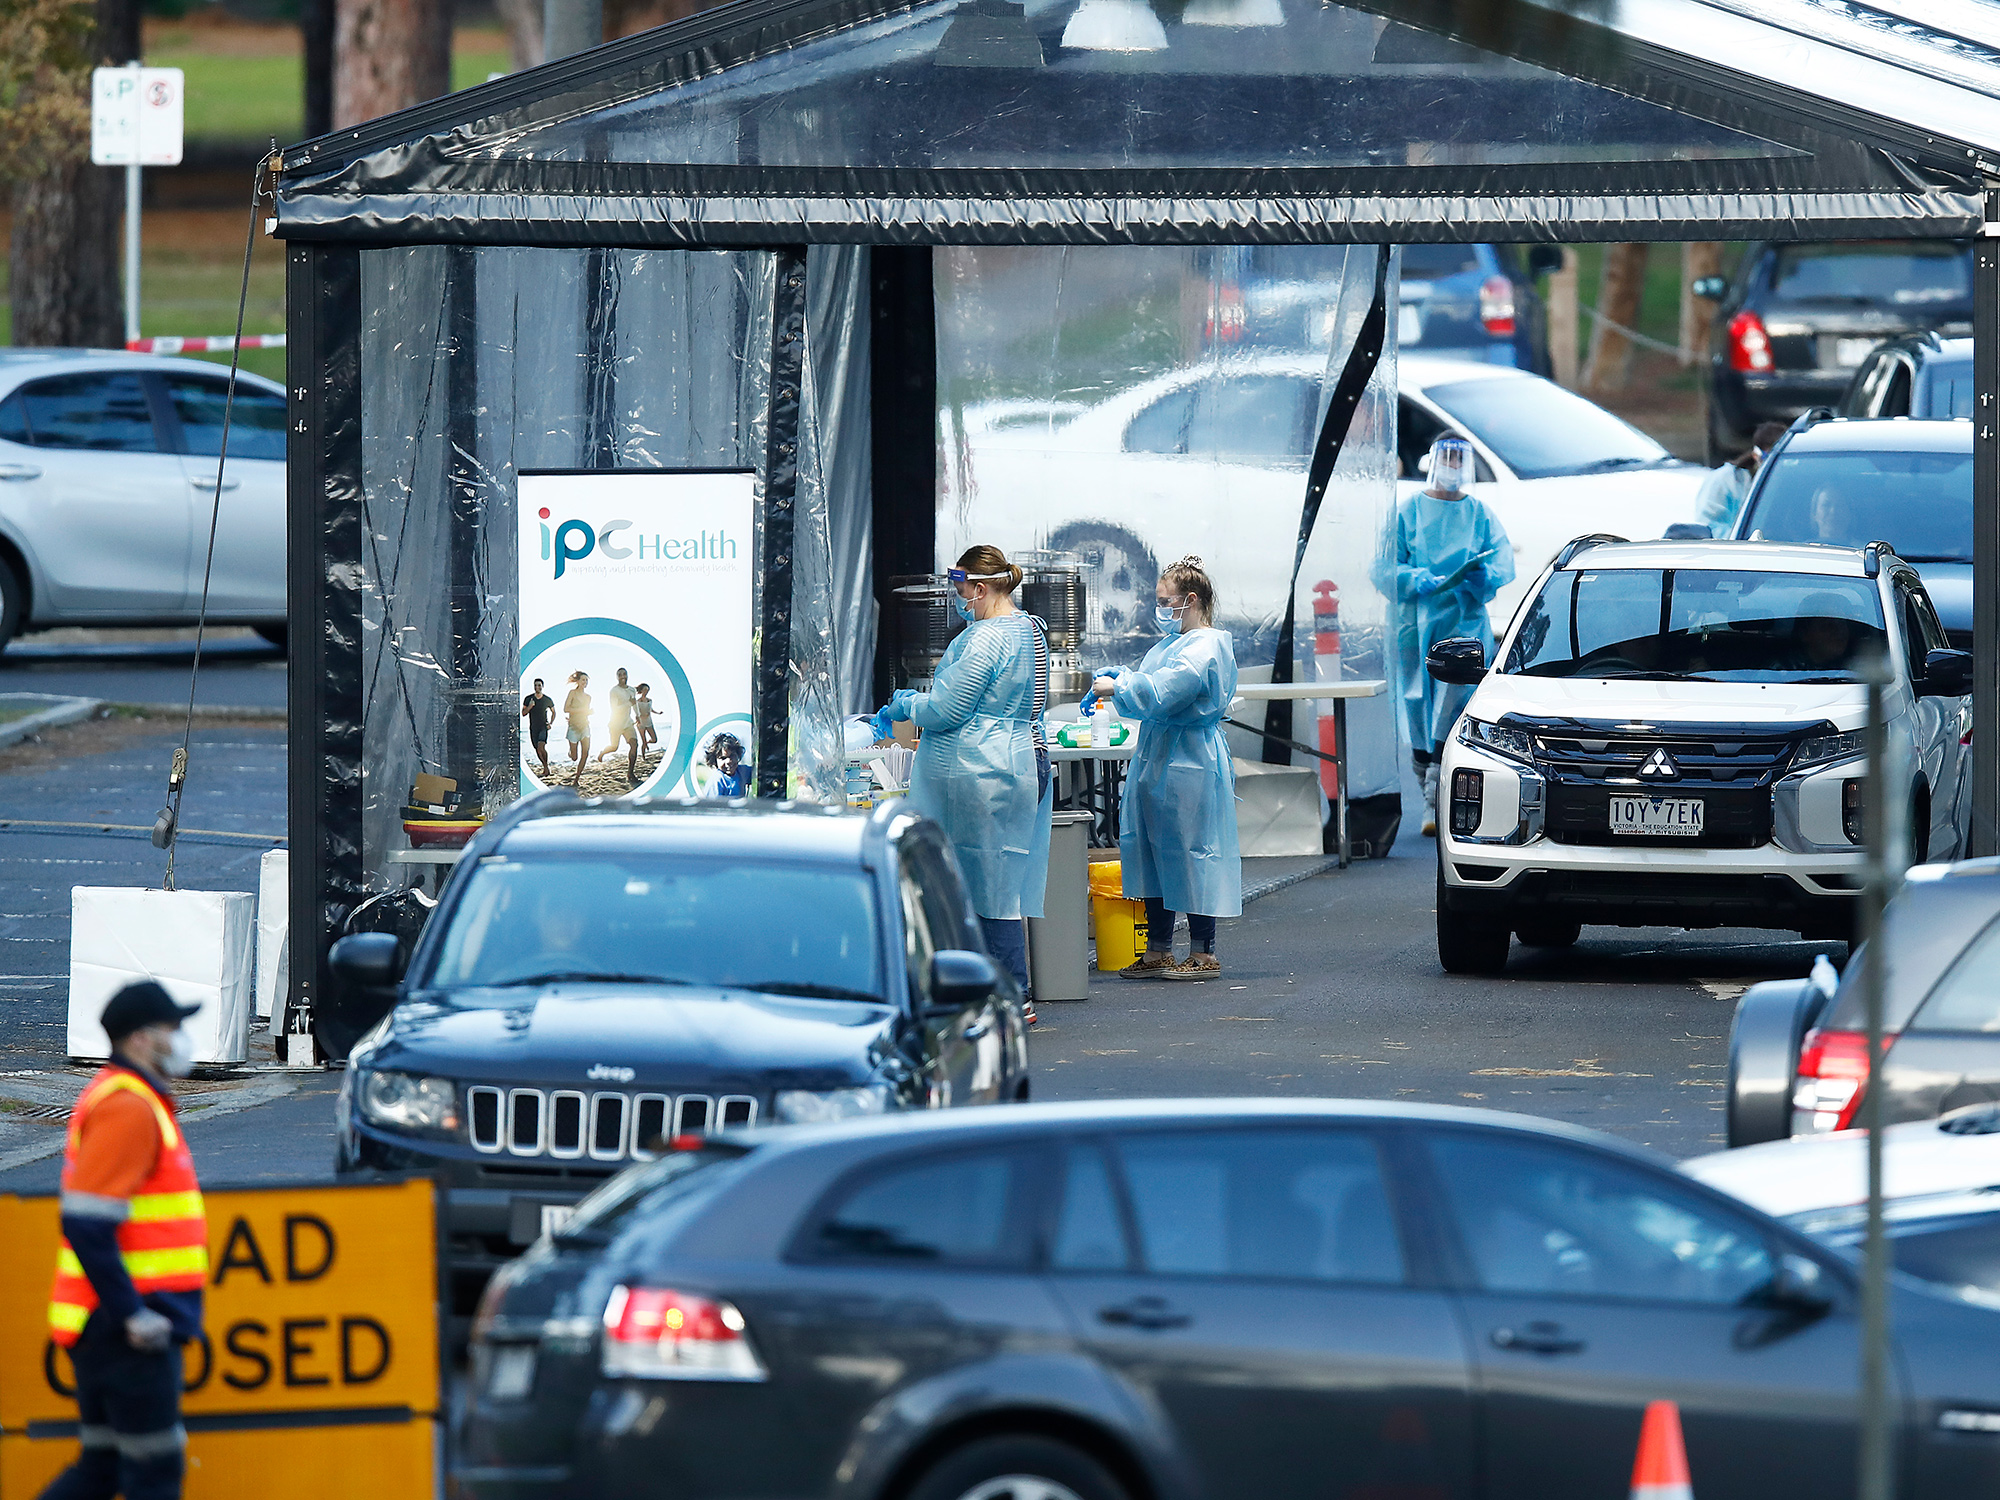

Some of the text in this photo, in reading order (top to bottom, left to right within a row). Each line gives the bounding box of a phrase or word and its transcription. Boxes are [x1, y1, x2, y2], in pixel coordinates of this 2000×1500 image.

[639, 530, 737, 560] Health
[1614, 801, 1701, 824] 1QY 7EK
[587, 1063, 636, 1083] Jeep
[213, 1215, 337, 1287] AD
